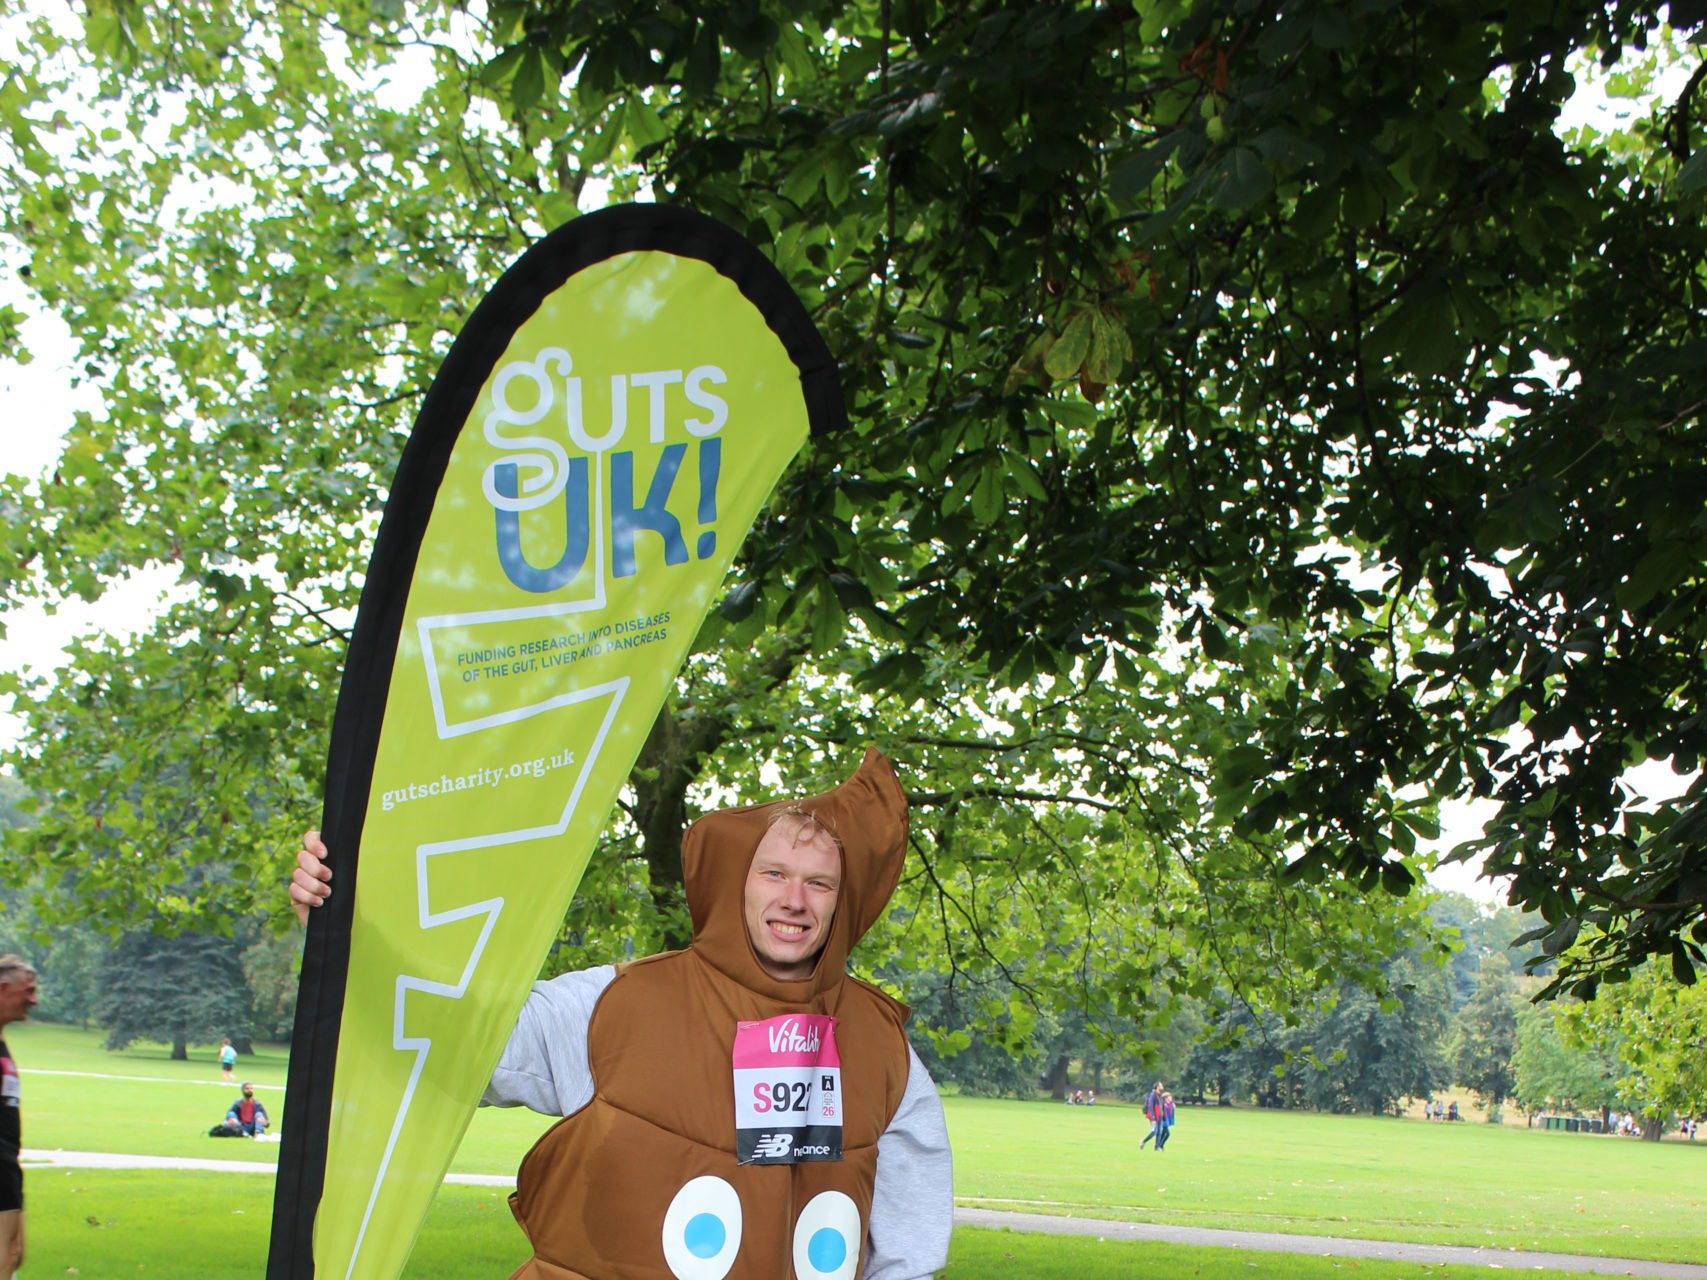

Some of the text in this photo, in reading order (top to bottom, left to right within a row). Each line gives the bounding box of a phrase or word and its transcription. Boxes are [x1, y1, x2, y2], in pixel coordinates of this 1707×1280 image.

[494, 437, 722, 593] UK!
[458, 612, 670, 665] FUNDING RESEARCH INTO DISEASES
[463, 629, 667, 683] OF THE GUT, LIVER AND PANCREAS
[382, 748, 574, 811] gutscharity.org.uk
[823, 1106, 835, 1117] 26
[825, 1080, 832, 1090] A
